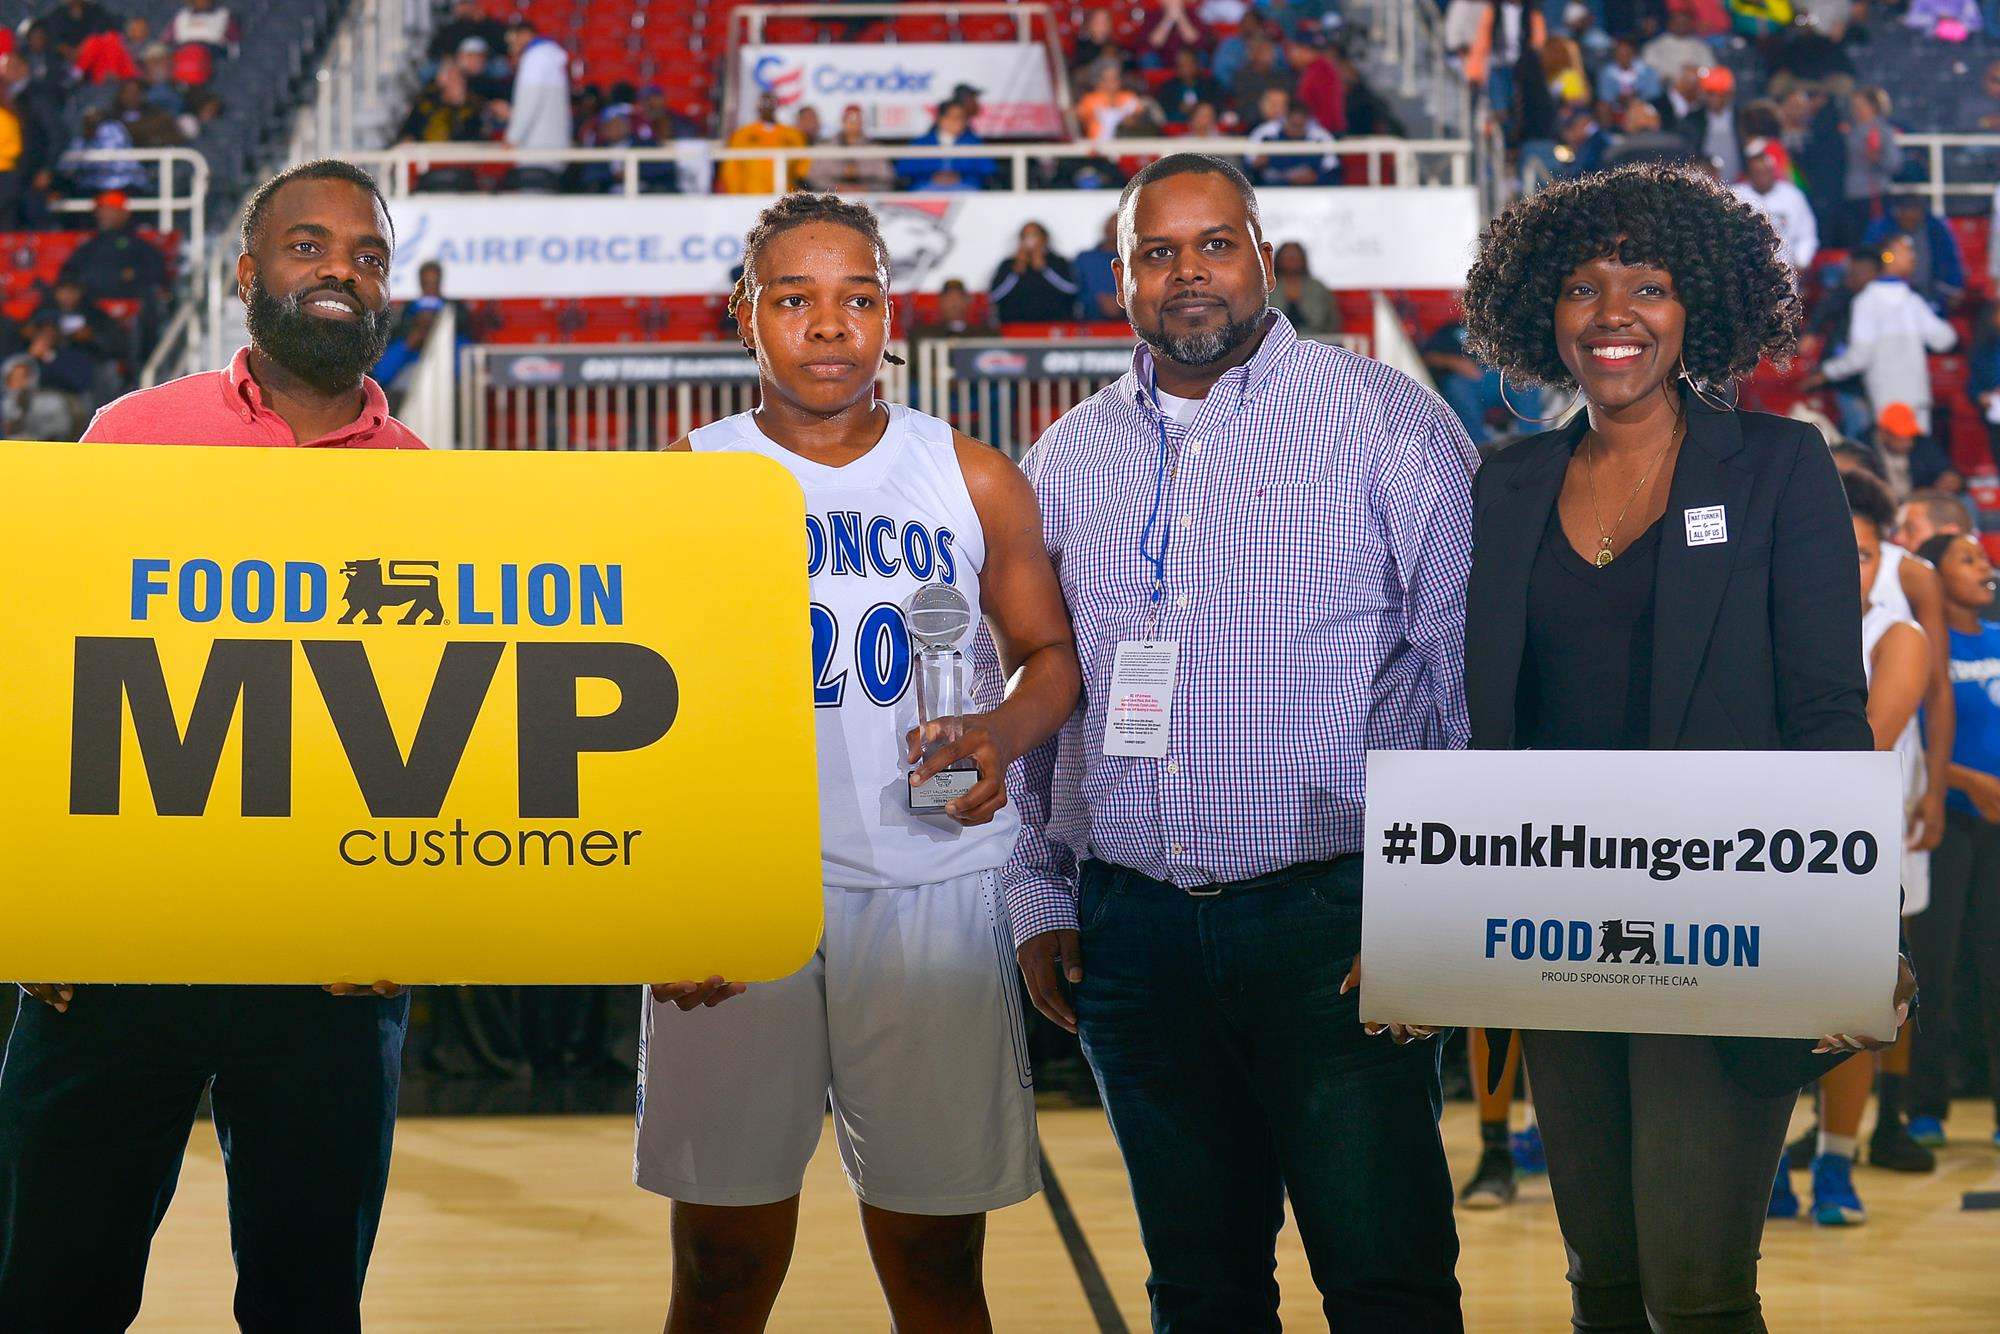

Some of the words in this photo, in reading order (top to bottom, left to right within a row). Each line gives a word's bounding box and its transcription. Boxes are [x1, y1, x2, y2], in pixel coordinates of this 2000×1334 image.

[435, 236, 742, 263] AIRFORCE.CO
[806, 511, 957, 586] ONCOS
[130, 558, 328, 624] FOOD
[458, 563, 624, 626] LION
[810, 602, 914, 708] 20
[69, 636, 680, 819] MVP
[338, 818, 643, 867] customer
[1382, 822, 1879, 881] #DunkHunger2020
[1484, 917, 1593, 961] FOOD
[1663, 923, 1760, 968] LION
[1541, 971, 1578, 982] PROUD
[1580, 973, 1630, 984] SPONSOR
[1632, 974, 1646, 985] OF
[1648, 975, 1669, 986] THE
[1671, 976, 1699, 987] CIAA
